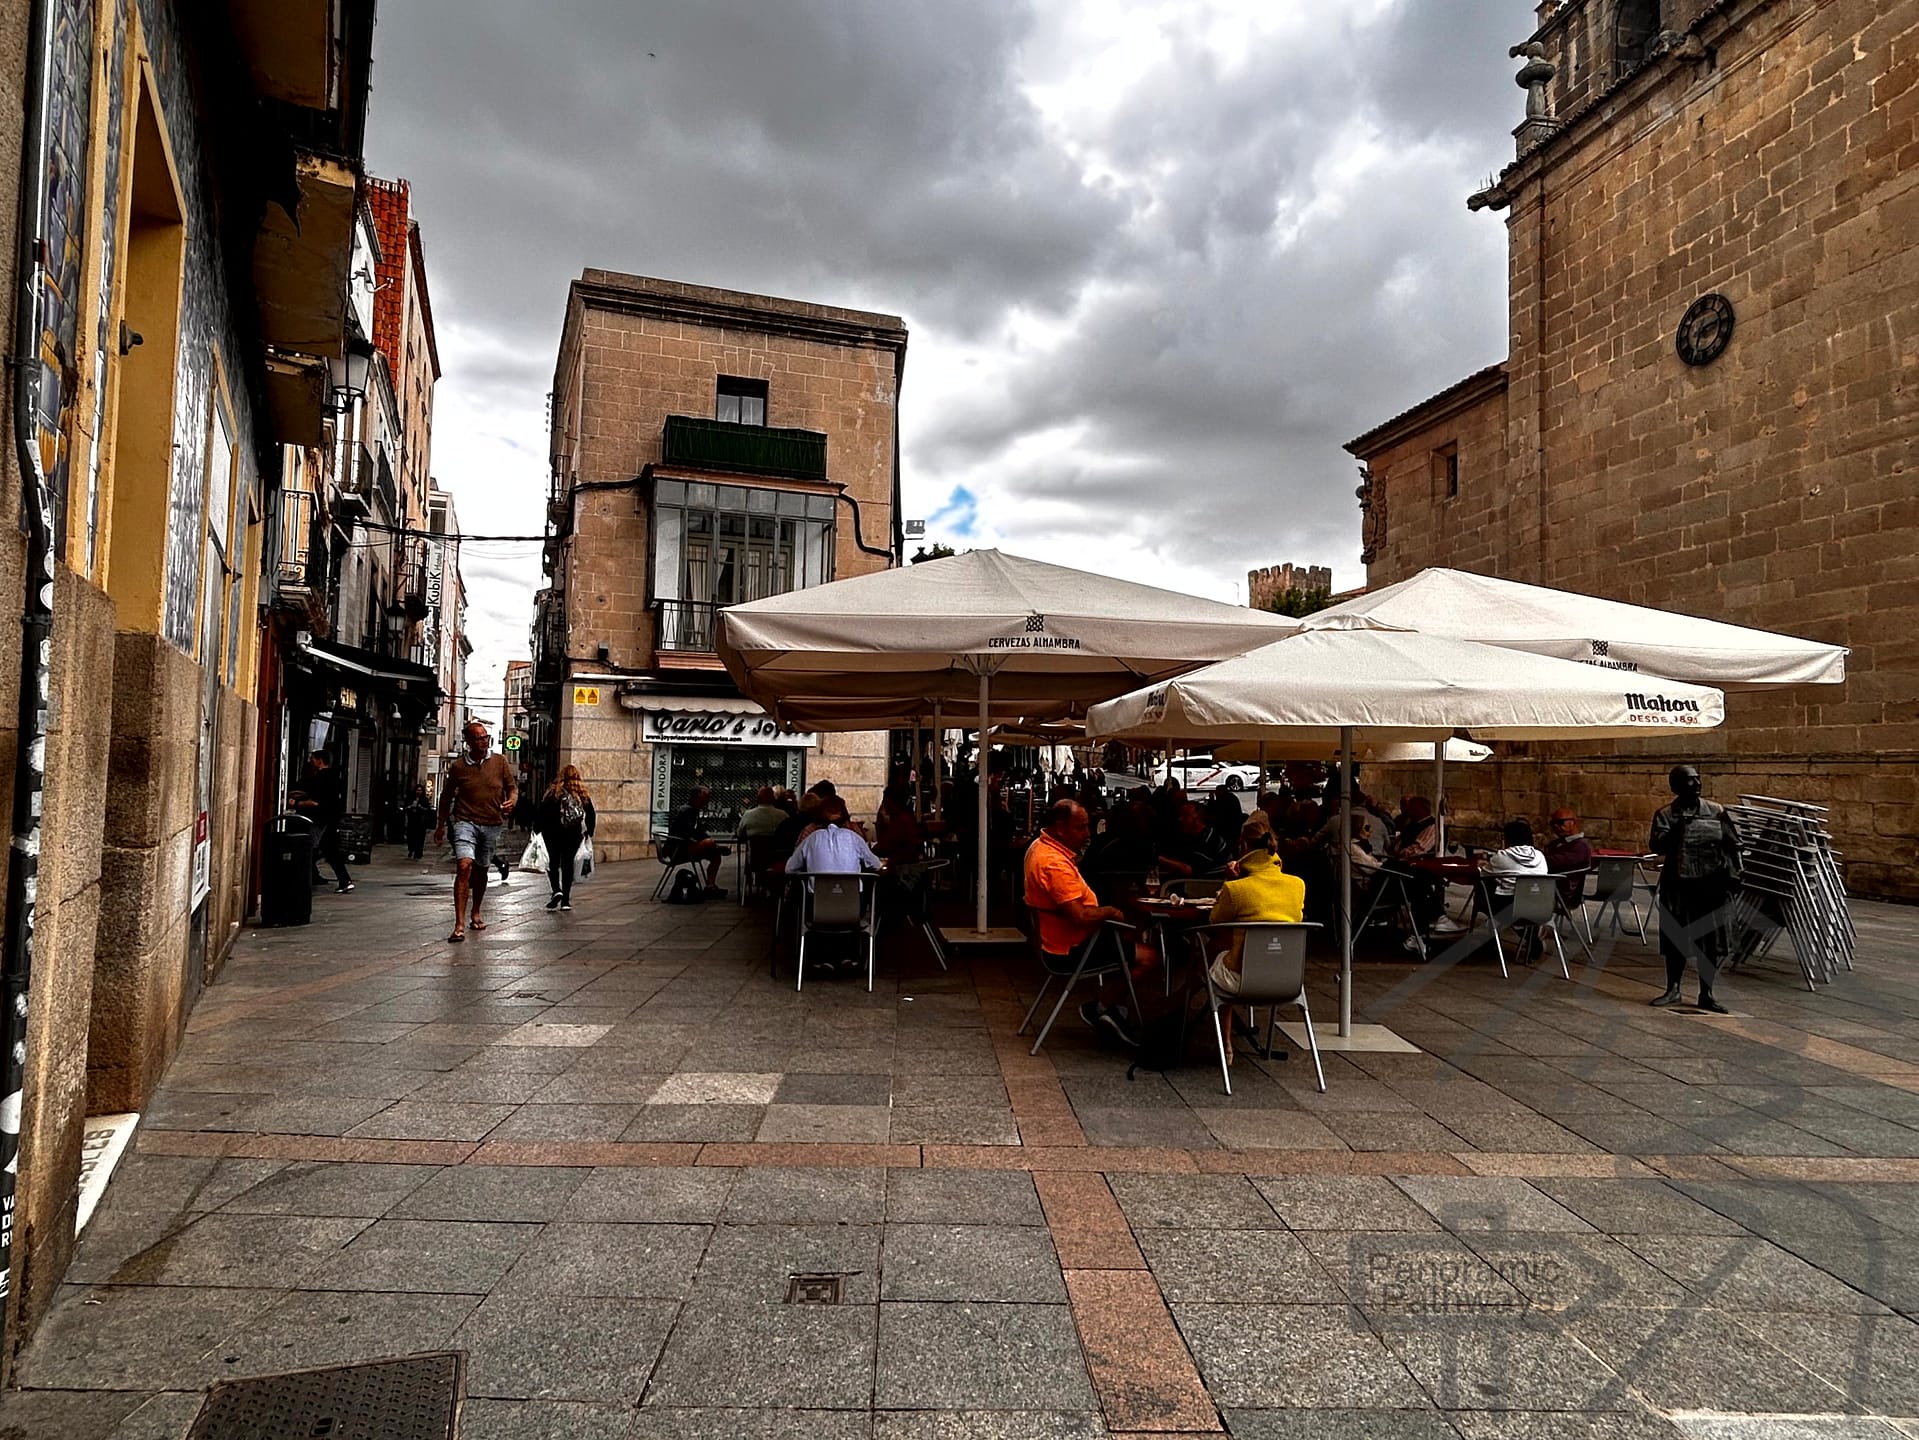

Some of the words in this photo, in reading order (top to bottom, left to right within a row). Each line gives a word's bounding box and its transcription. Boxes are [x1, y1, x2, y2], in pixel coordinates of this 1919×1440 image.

[427, 571, 441, 605] KubiK
[988, 636, 1031, 648] CERVEZAS
[1033, 636, 1081, 649] ALHAMBRA
[1624, 693, 1700, 712] Mahou
